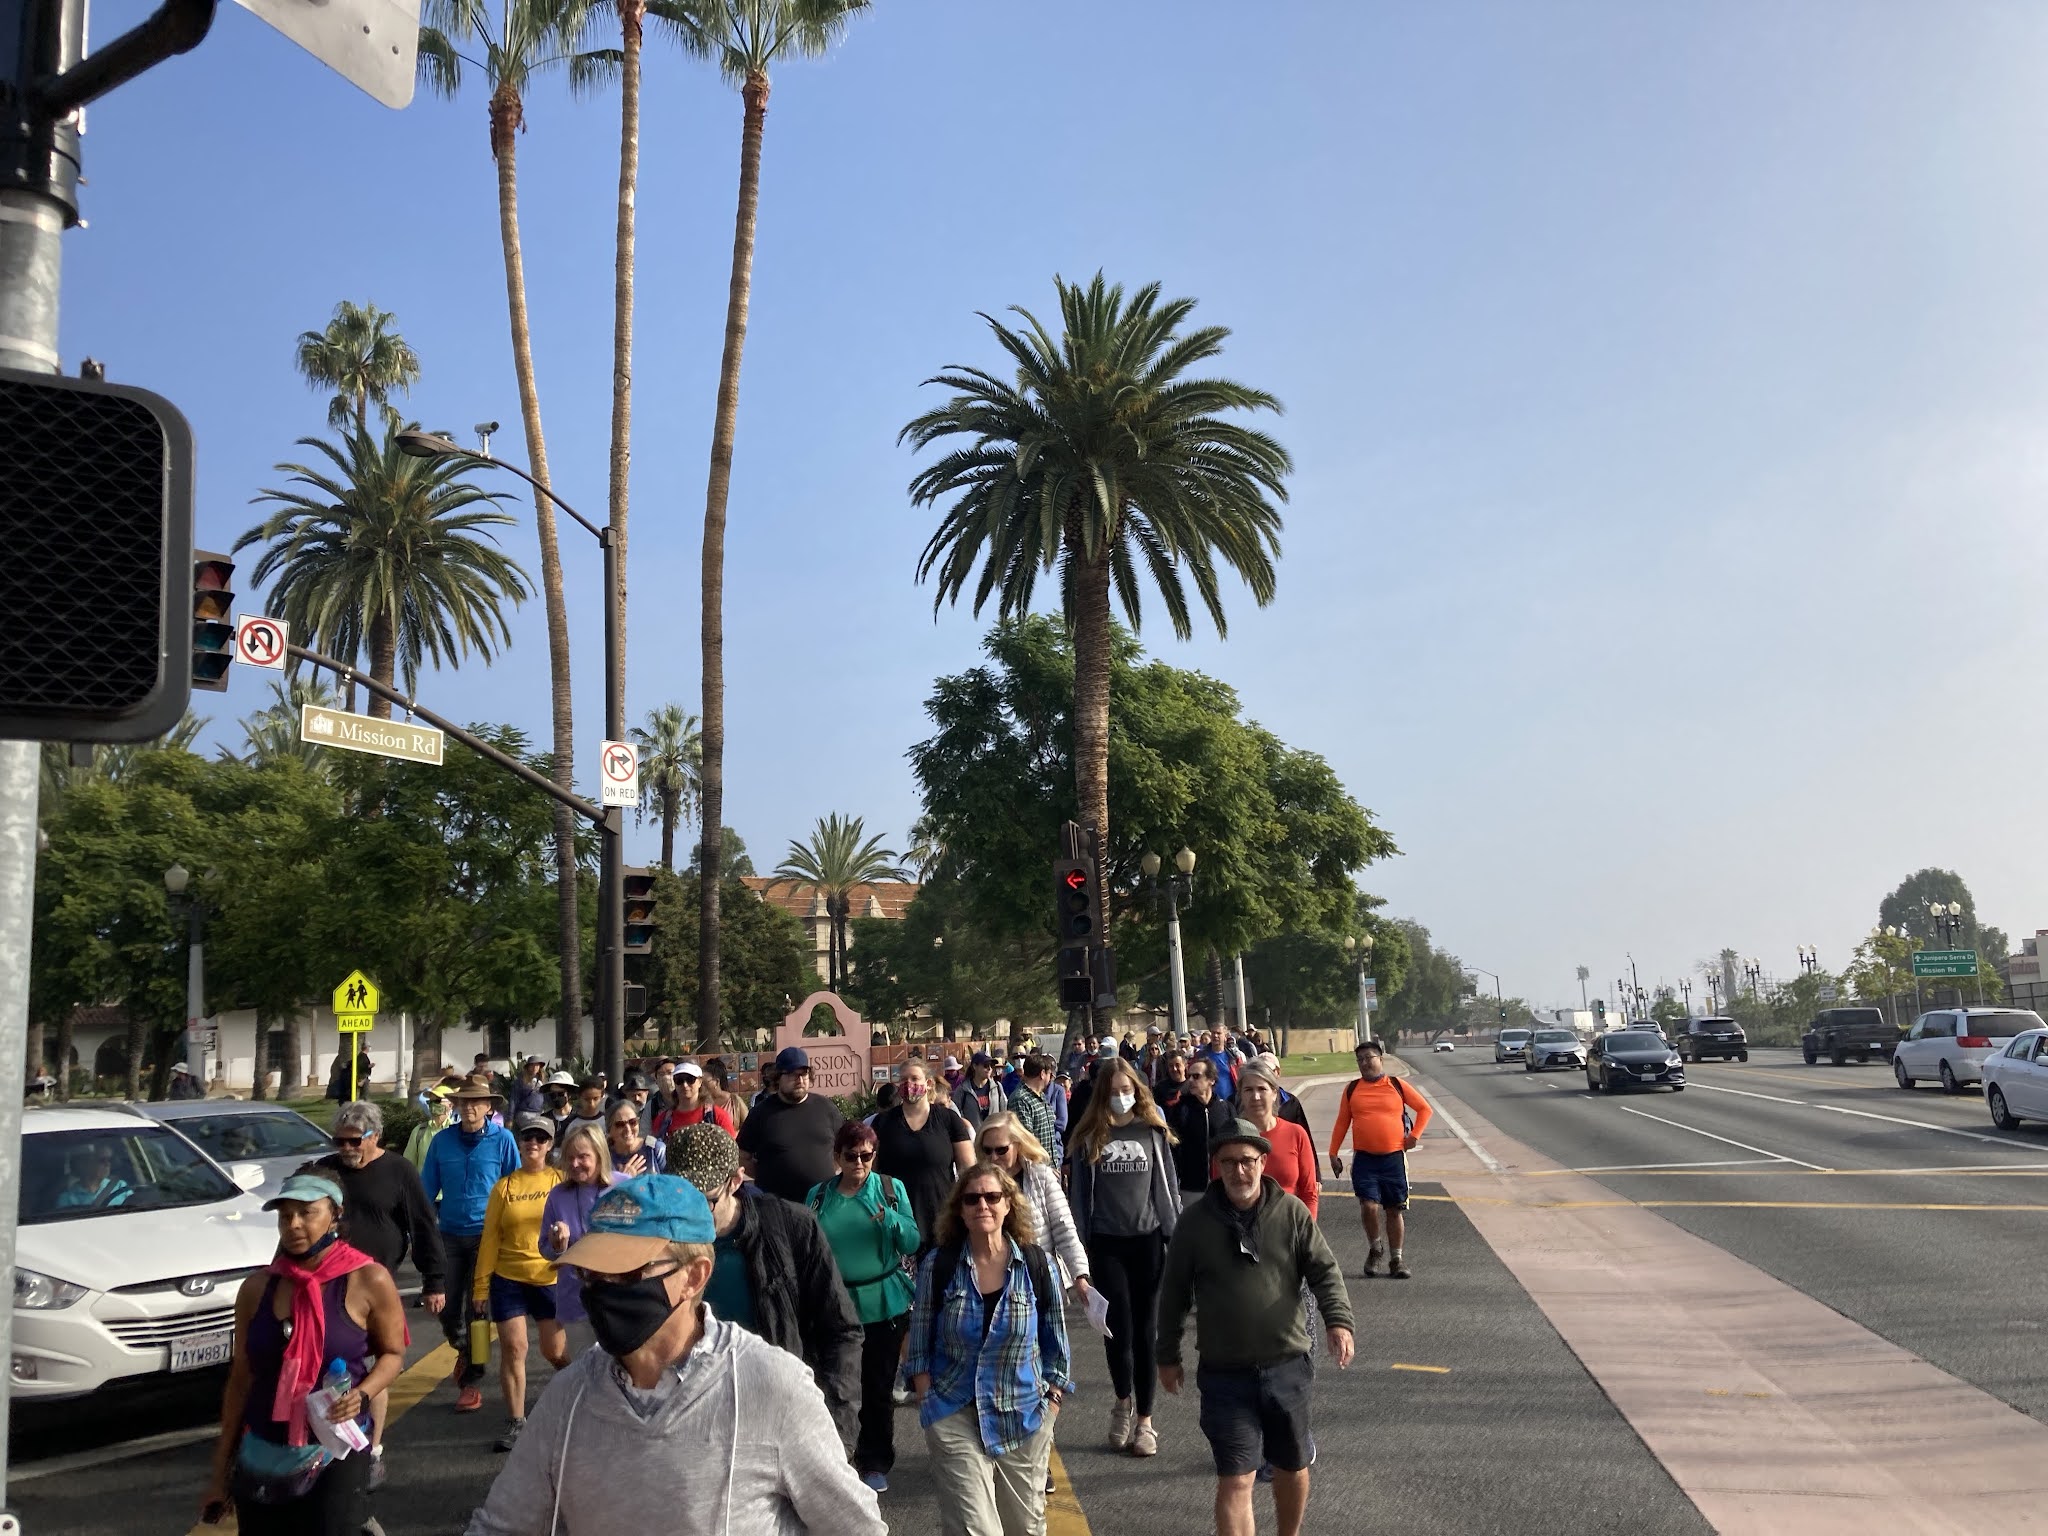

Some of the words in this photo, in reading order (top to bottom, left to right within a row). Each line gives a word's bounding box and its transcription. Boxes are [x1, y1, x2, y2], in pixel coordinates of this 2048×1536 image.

[338, 720, 407, 750] Mission
[412, 734, 436, 756] Rd
[604, 786, 616, 798] ON
[619, 788, 636, 799] RED
[1920, 966, 1946, 974] Mission
[341, 1018, 370, 1028] AHEAD
[809, 1055, 853, 1071] ISSION
[809, 1072, 859, 1089] STRICT
[1100, 1160, 1149, 1173] CALIFORNIA
[174, 1343, 229, 1368] 7AYW887
